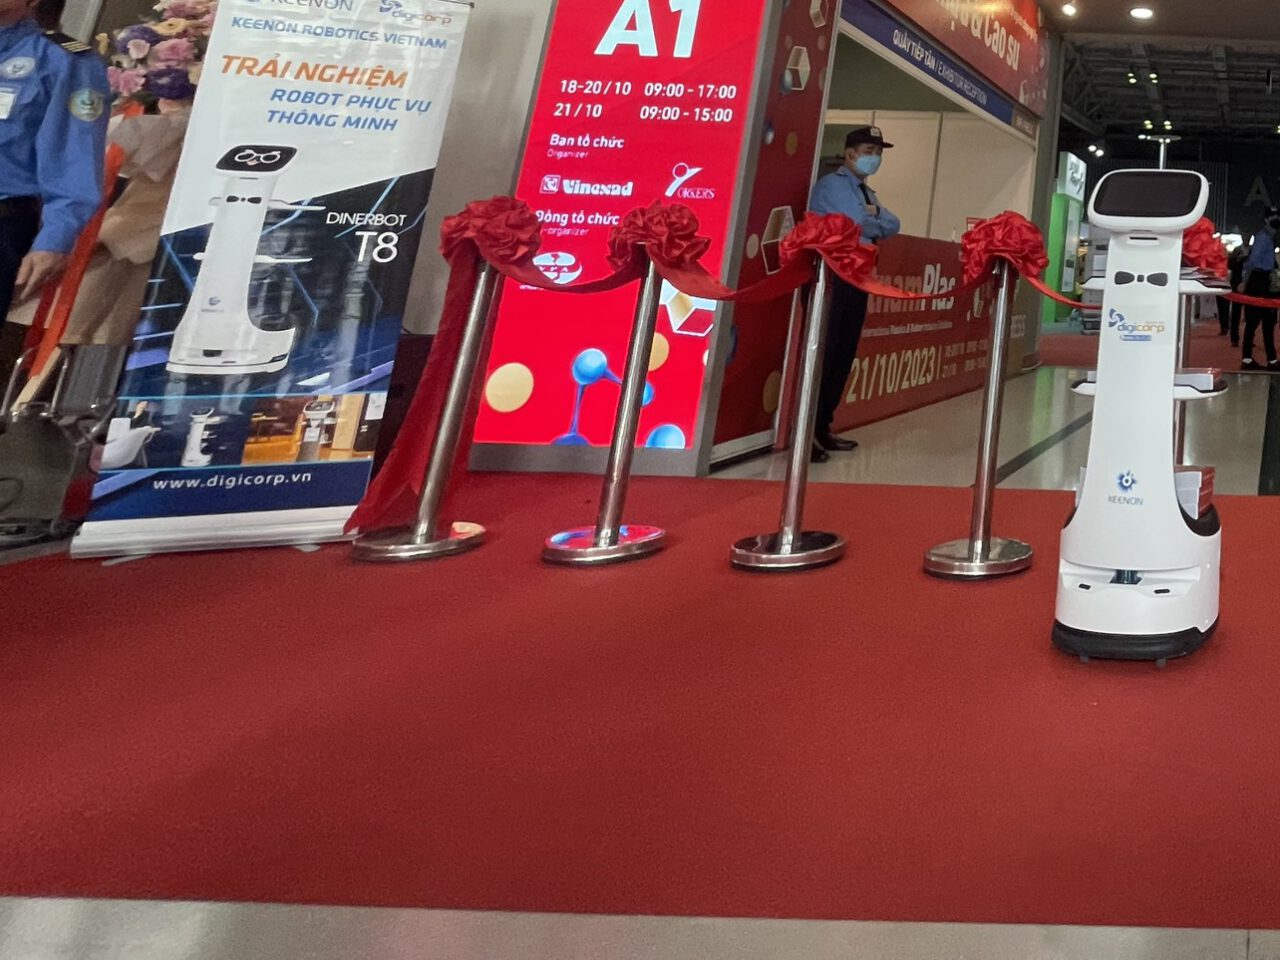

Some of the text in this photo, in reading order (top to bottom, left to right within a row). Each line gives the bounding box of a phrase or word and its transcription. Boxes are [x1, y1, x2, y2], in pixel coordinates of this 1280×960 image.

[391, 9, 452, 25] digicorp
[232, 16, 447, 49] KEENON ROBOTICS VIETNAM
[221, 52, 408, 90] TRẢI NGHIỆM
[559, 79, 602, 95] 18-20
[615, 81, 631, 96] 10
[644, 82, 684, 98] 09:00
[698, 84, 737, 99] 17:00
[270, 89, 431, 116] ROBOT PHỤC VỤ
[553, 103, 571, 117] 21
[585, 103, 602, 118] 10
[639, 105, 680, 121] 09:00
[693, 107, 733, 122] 15:00
[267, 109, 398, 131] THÔNG MINH
[550, 133, 574, 146] Ban
[593, 136, 624, 149] chức
[547, 148, 588, 159] Organizer
[326, 212, 407, 227] DINERBOT
[587, 212, 619, 225] chức
[540, 227, 589, 237] -organizer
[354, 230, 399, 263] T8
[846, 345, 935, 404] 21/10/2023
[152, 470, 312, 490] www.digicorp.vn
